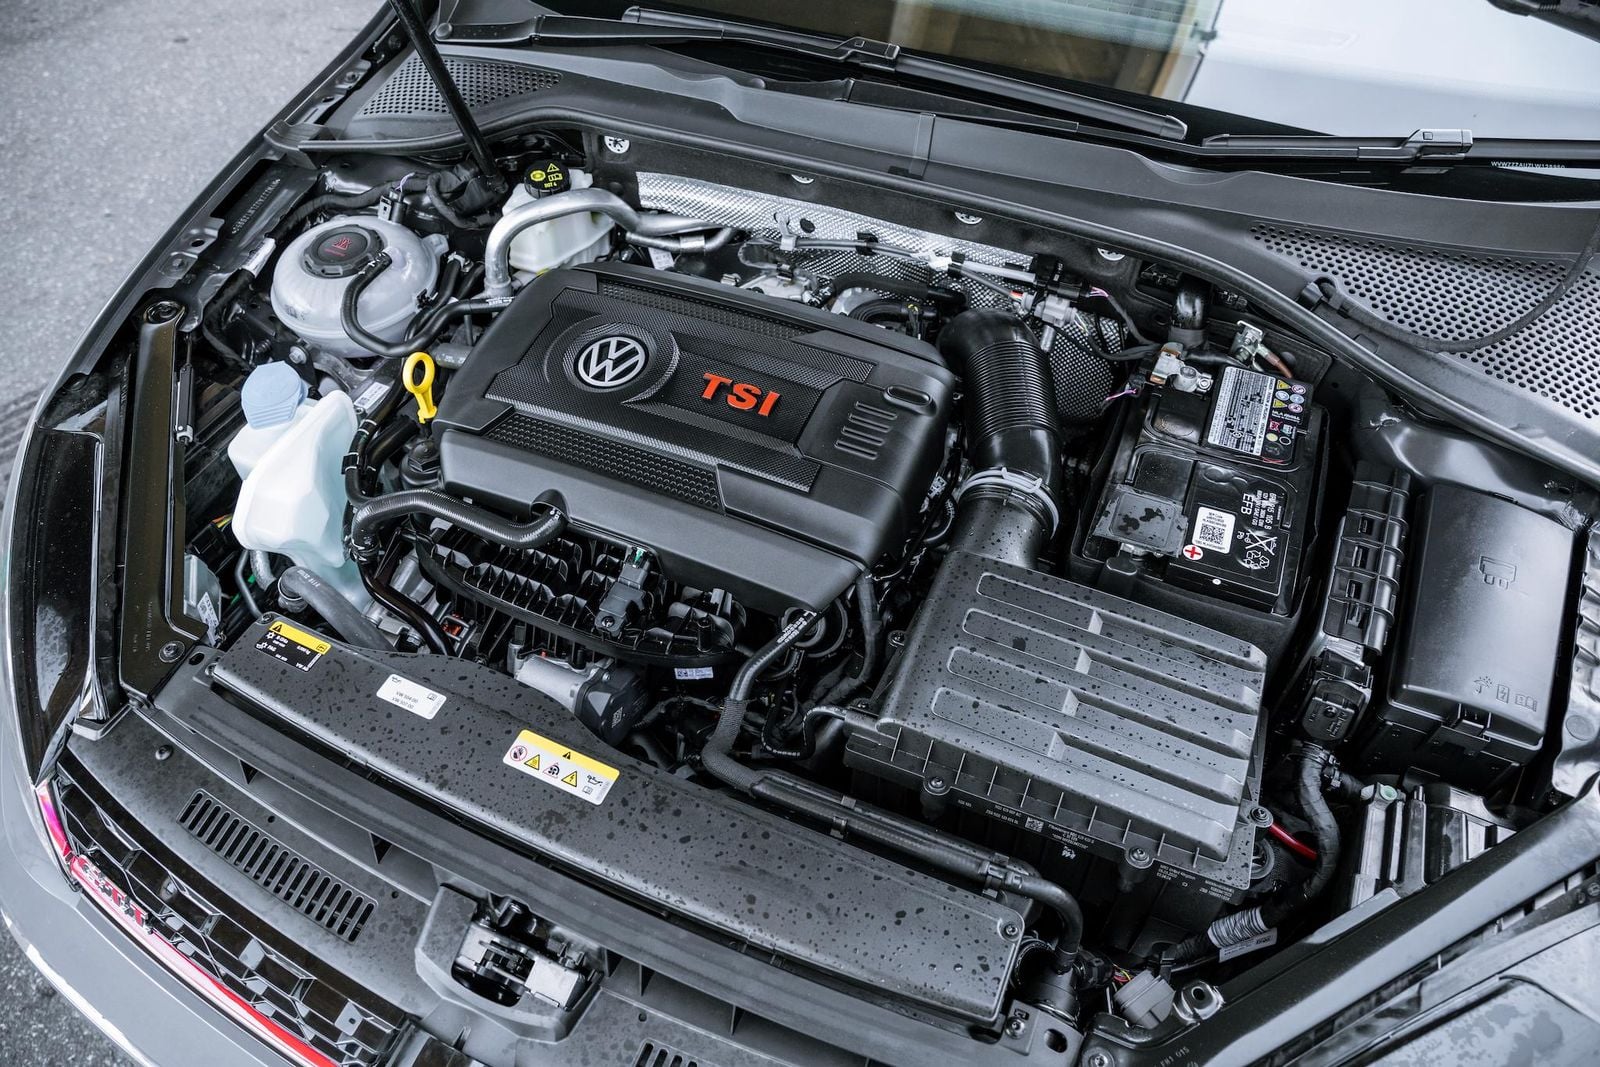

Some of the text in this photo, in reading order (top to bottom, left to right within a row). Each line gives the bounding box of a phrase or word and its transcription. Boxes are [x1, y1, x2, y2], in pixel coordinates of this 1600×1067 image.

[578, 336, 646, 387] VW
[701, 372, 781, 417] TSI
[1239, 493, 1255, 515] EFB
